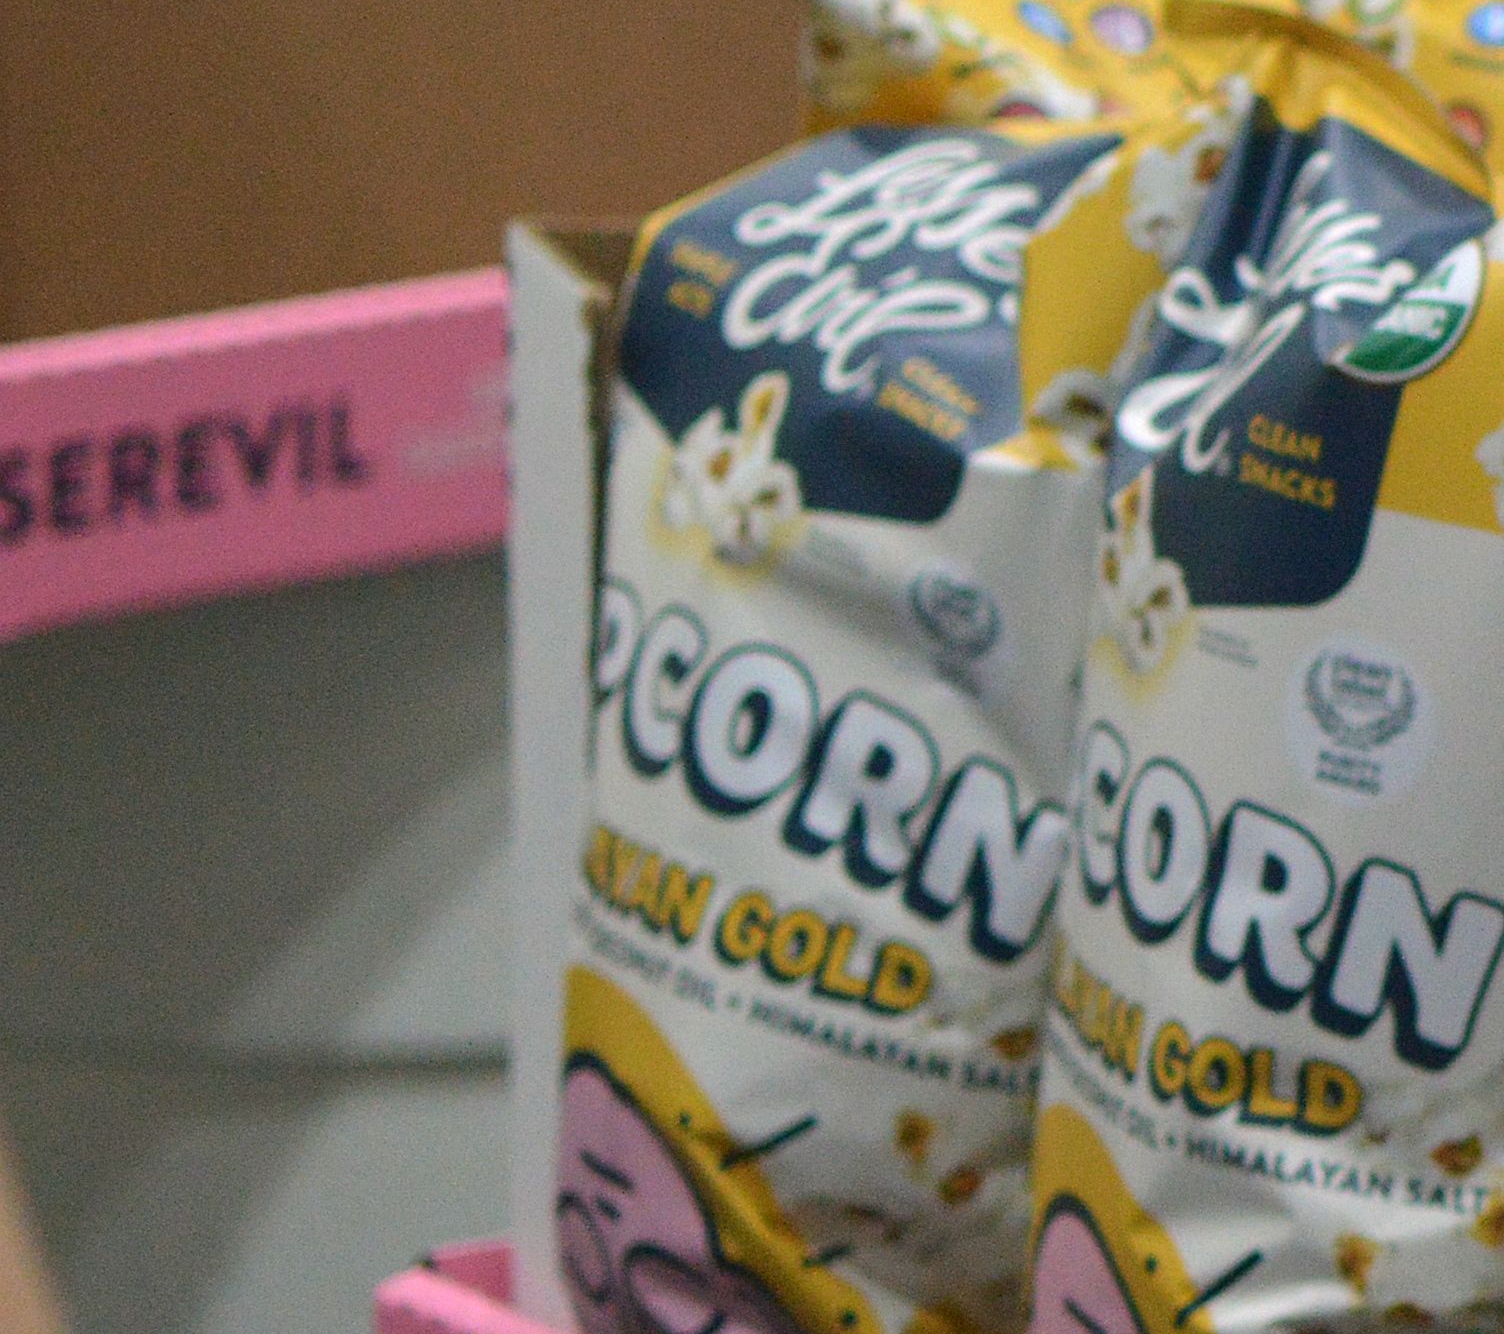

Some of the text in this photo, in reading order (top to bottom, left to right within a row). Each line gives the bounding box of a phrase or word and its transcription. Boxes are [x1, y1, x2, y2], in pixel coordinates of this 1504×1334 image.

[712, 888, 935, 1013] GOLD
[1147, 1019, 1364, 1138] GOLD
[1186, 1135, 1492, 1217] HIMALAYAN SALT
